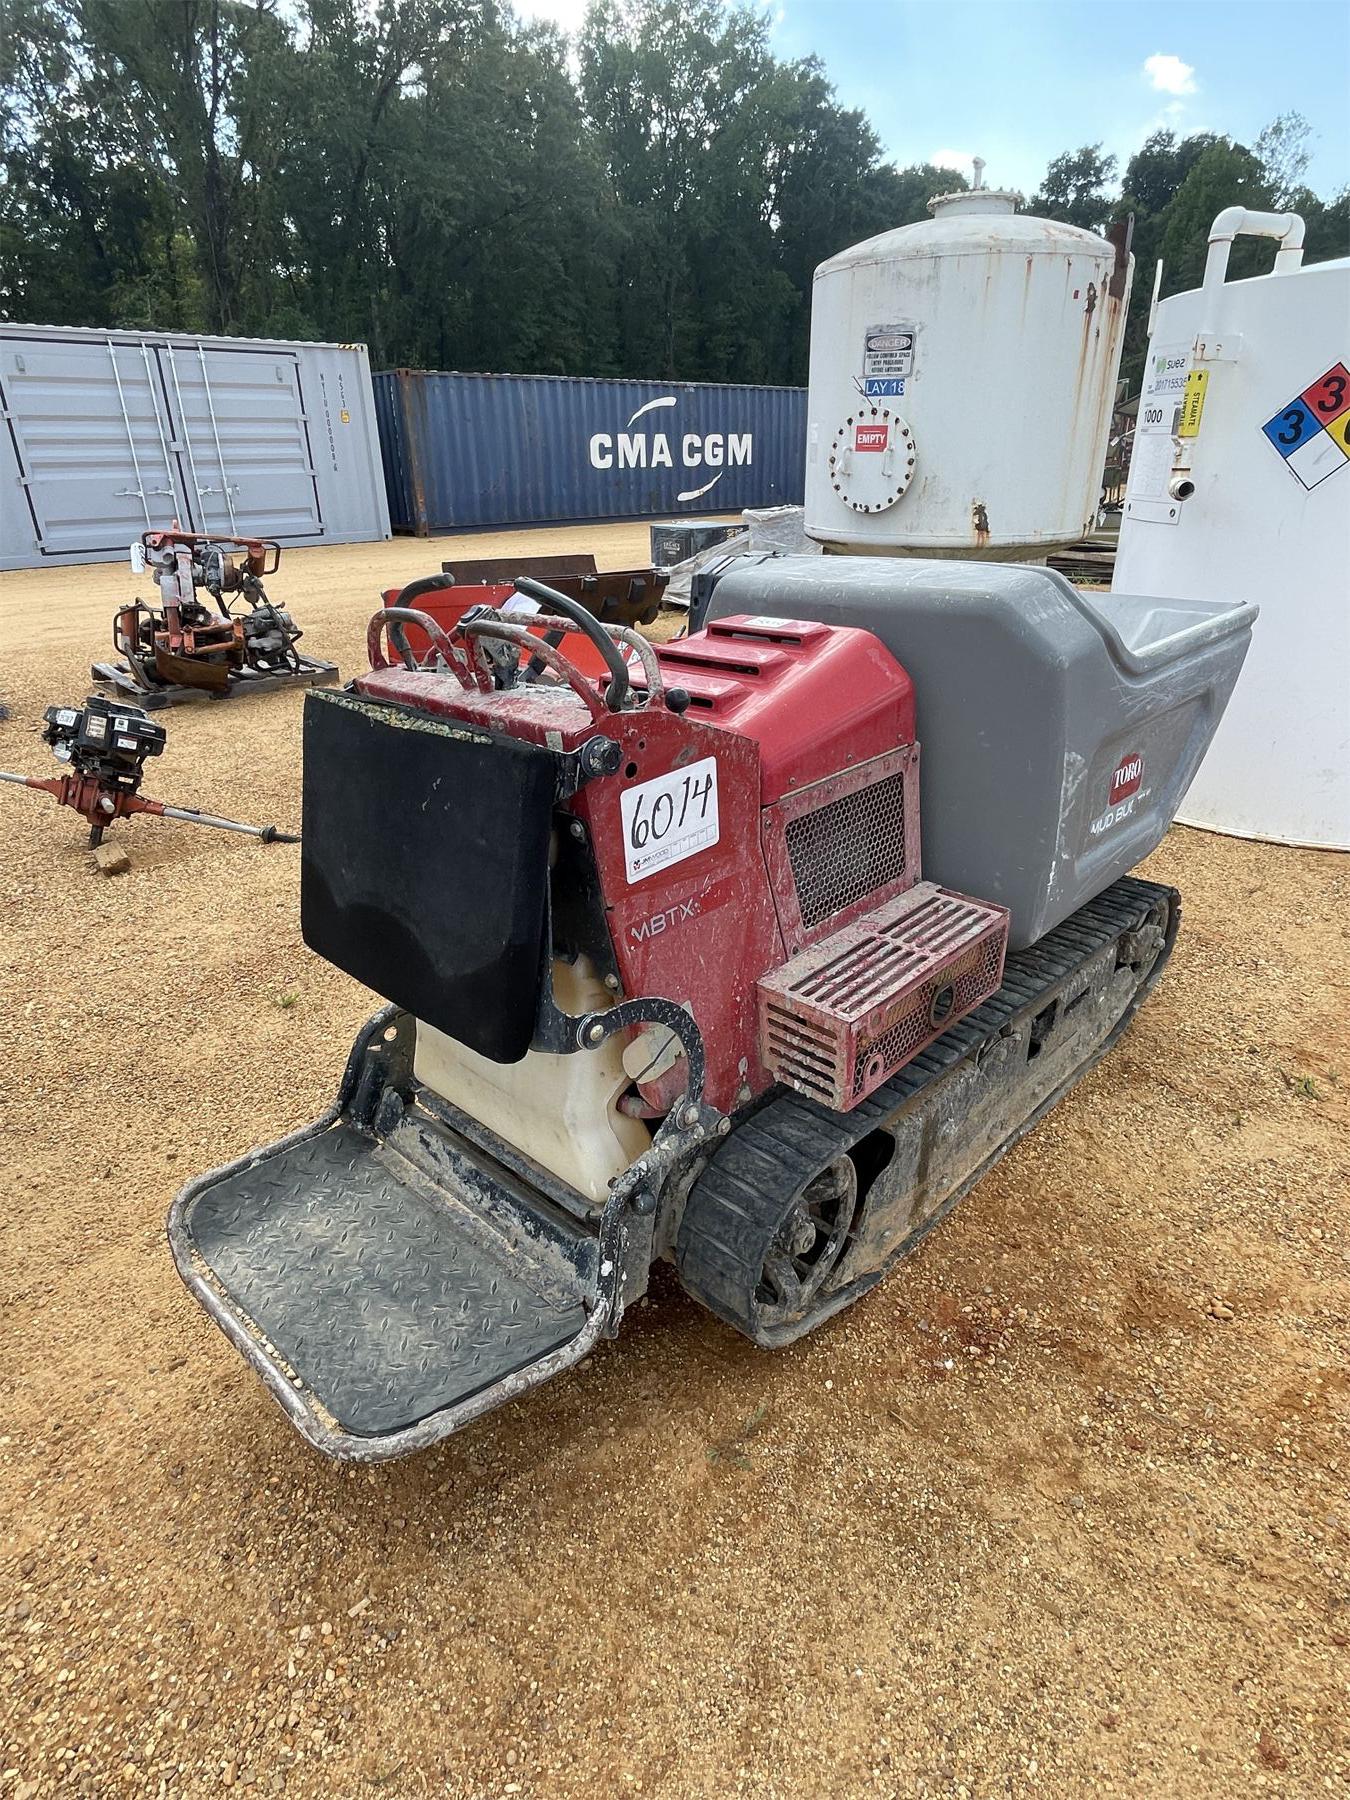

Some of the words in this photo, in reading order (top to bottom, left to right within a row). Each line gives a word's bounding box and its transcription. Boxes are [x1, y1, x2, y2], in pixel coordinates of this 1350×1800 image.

[871, 338, 908, 348] DANGER
[1167, 358, 1186, 370] suez
[866, 381, 888, 394] LAY
[892, 381, 905, 394] 18
[1317, 376, 1347, 413] 3
[1145, 409, 1163, 424] 1000
[1278, 409, 1305, 444] 3
[590, 433, 673, 469] CMA
[682, 433, 752, 467] CGM
[857, 433, 886, 444] EMPTY
[1114, 758, 1141, 789] TORO
[631, 773, 713, 849] 6014
[1090, 812, 1114, 834] MUD
[631, 898, 695, 942] MBTX
